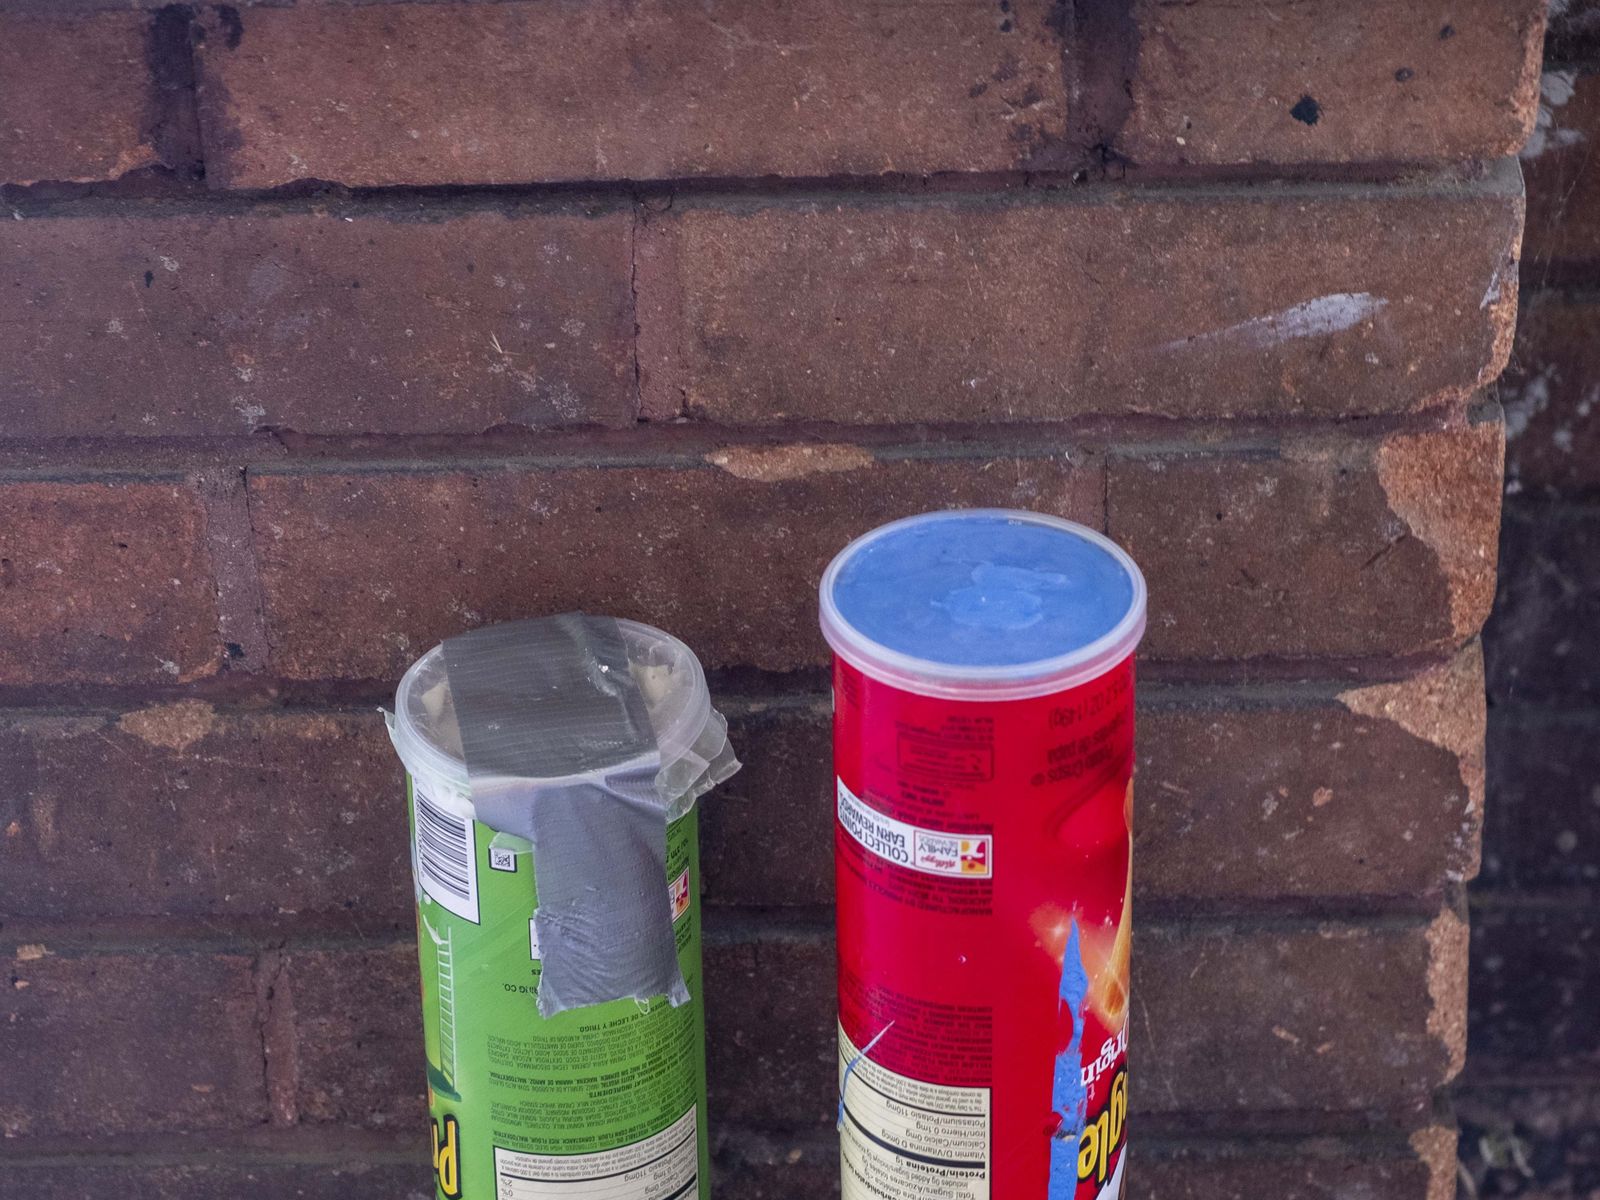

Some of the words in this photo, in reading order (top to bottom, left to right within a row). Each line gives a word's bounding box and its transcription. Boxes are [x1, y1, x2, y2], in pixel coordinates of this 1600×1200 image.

[875, 825, 905, 847] EARN
[863, 834, 909, 863] COLLECT
[918, 842, 958, 858] FAMILY
[502, 984, 517, 992] CO.
[577, 1024, 600, 1032] TRIGO.
[609, 1017, 629, 1027] LECHE
[587, 1084, 632, 1098] INGREDIENTS.
[886, 1100, 909, 1116] 110mg
[910, 1111, 985, 1128] Potassium/Potasio
[905, 1129, 922, 1140] 0mg
[916, 1122, 939, 1135] 0.1mg
[941, 1128, 985, 1137] Iron/Hierro
[901, 1140, 908, 1149] D
[923, 1135, 985, 1149] Calcium/Calcio
[909, 1142, 953, 1158] D/Vitamina
[954, 1151, 985, 1159] Vitamin
[624, 1170, 647, 1182] 110mg
[906, 1161, 985, 1179] Protein/Proteína
[500, 1178, 512, 1187] 2%
[889, 1175, 954, 1199] Sugars/Azúcares
[501, 1188, 513, 1197] 0%
[644, 1184, 659, 1194] 0mg
[956, 1192, 976, 1200] Total
